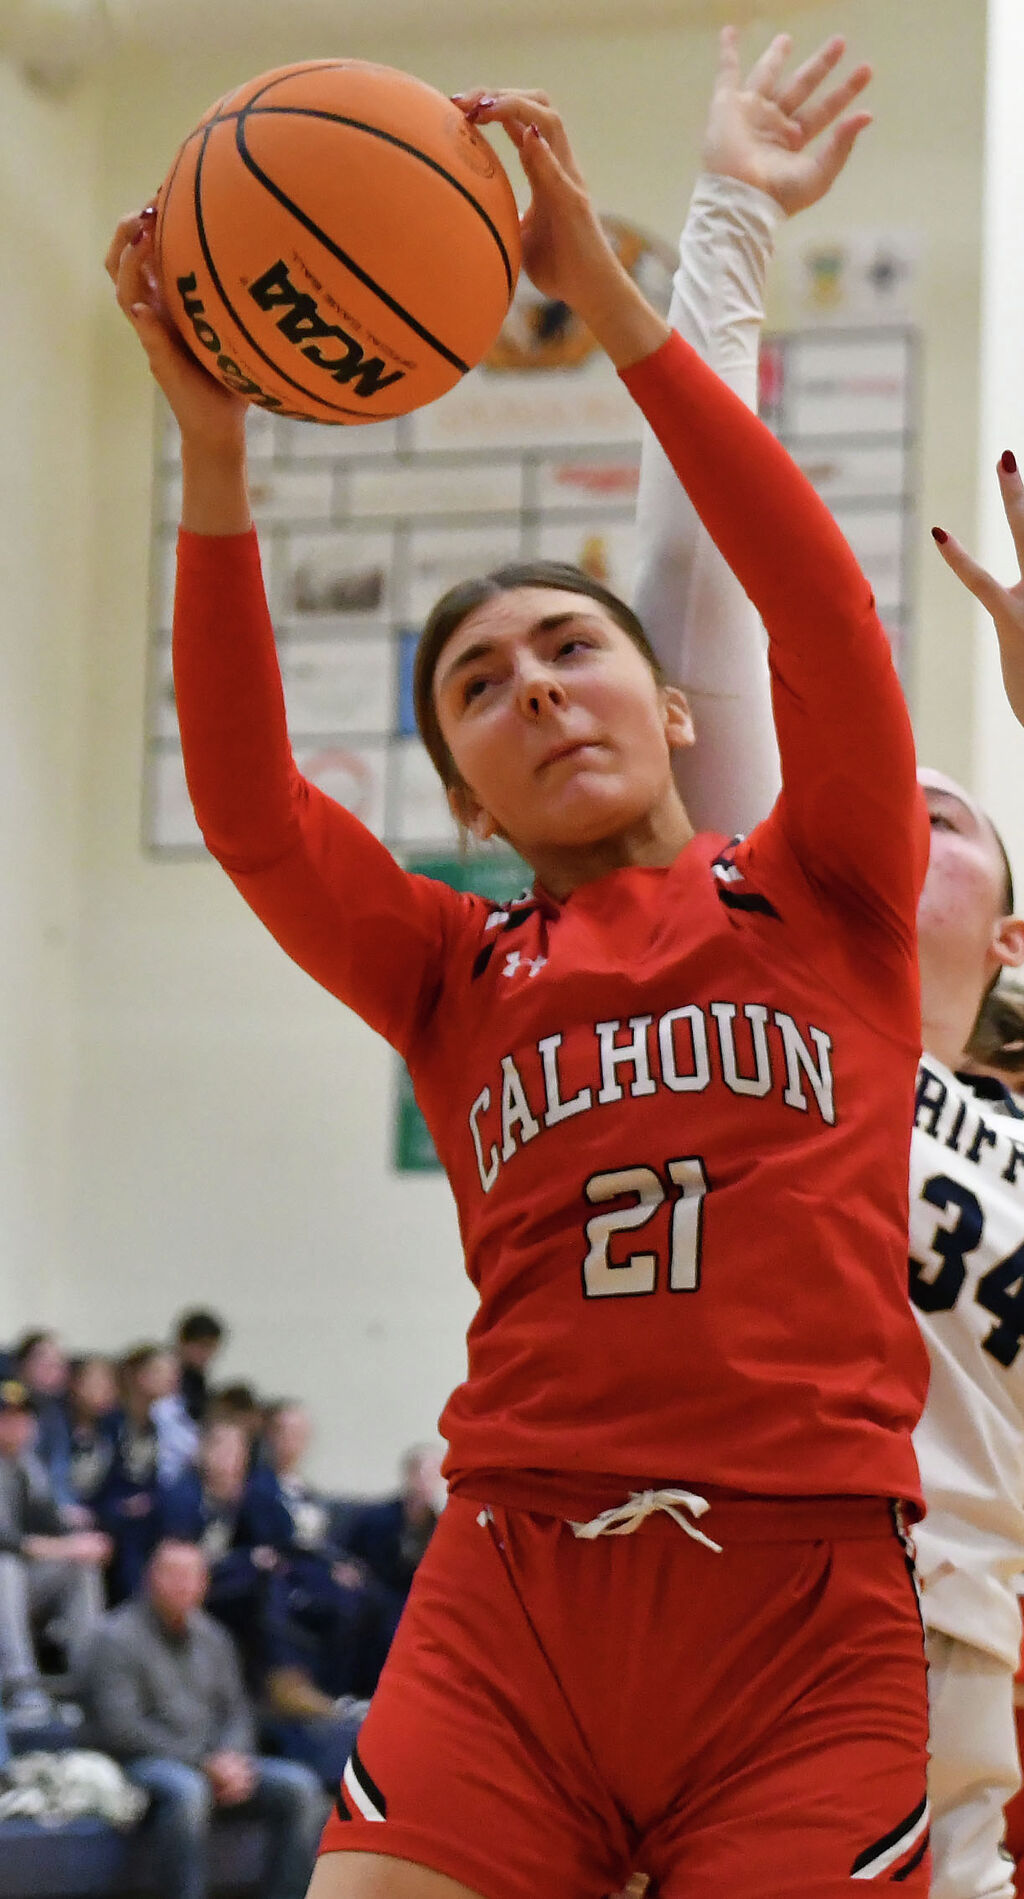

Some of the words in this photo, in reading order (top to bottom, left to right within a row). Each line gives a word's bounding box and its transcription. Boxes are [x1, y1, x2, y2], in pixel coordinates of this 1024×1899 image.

[248, 259, 406, 398] NCAA
[468, 1000, 838, 1195] CALHOUN
[582, 1154, 710, 1299] 21
